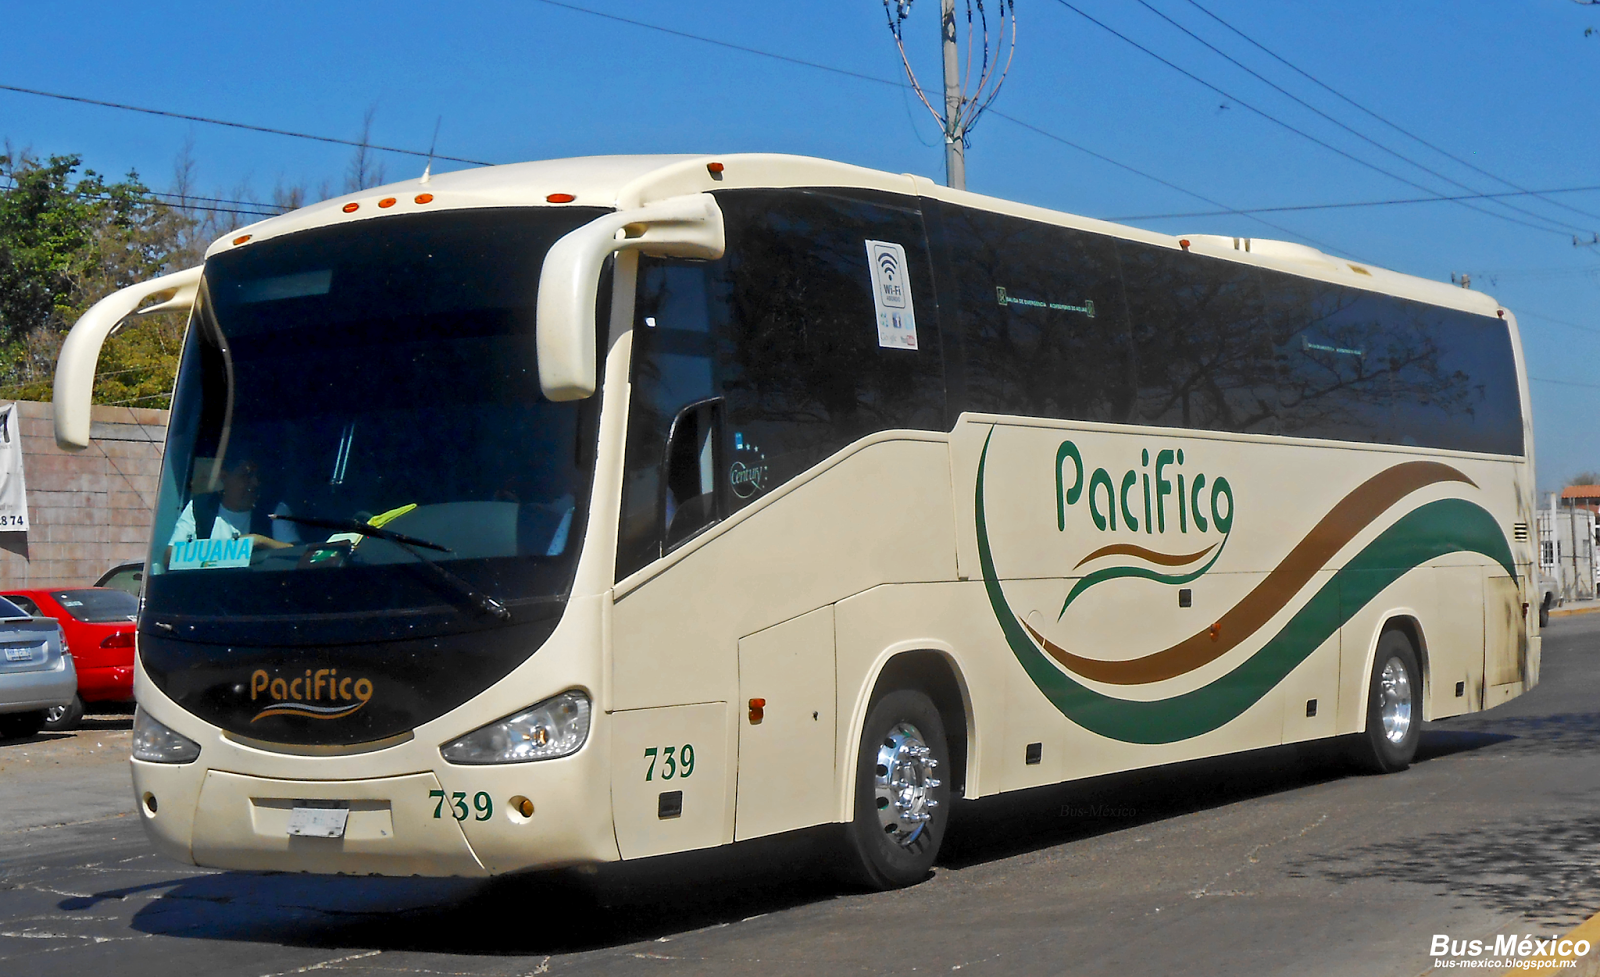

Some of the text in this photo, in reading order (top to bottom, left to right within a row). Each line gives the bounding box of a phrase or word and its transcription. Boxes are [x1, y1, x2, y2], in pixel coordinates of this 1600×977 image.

[883, 284, 902, 296] Wi-Fi
[0, 515, 24, 526] 8 74
[174, 538, 250, 562] TIJUANA
[644, 744, 695, 781] 739
[429, 790, 493, 821] 739
